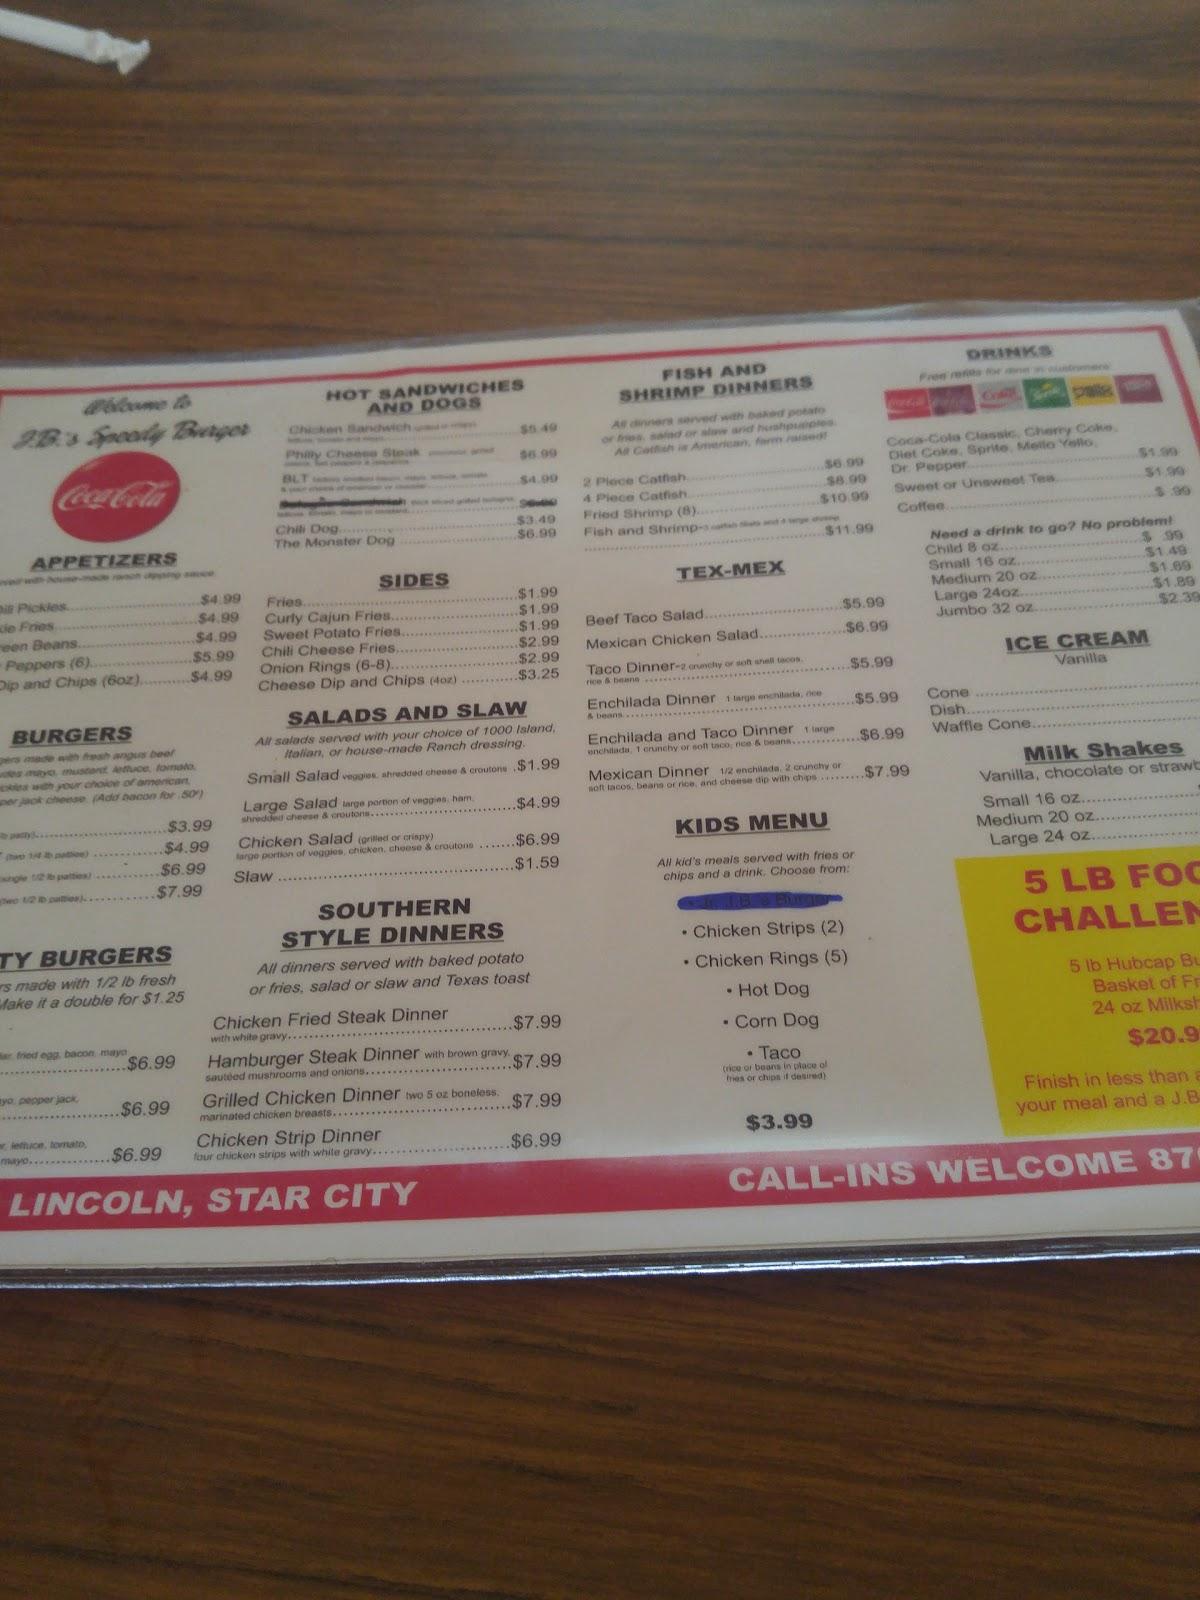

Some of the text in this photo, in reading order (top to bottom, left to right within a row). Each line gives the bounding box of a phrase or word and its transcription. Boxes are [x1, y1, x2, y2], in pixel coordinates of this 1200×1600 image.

[967, 345, 1053, 361] DRINKS
[662, 364, 766, 381] FISH AND
[326, 380, 524, 401] HOT SANDWICHES
[618, 376, 813, 403] SHRIMP DINNERS
[368, 397, 482, 416] AND DOGS
[87, 425, 166, 447] Speedy
[172, 420, 250, 440] Burger
[583, 458, 864, 487] 2 Piece Catfish $6.99
[584, 510, 618, 520] Fried
[624, 508, 673, 519] Shrimp
[897, 501, 945, 512] Coffee
[274, 528, 556, 549] The Monster Dog $6.99
[931, 516, 1173, 541] Need a drink to go? No problem!
[30, 553, 178, 571] APPETIZERS
[929, 545, 1187, 571] Small 16 oz $1.49
[677, 560, 785, 580] TEX-MEX
[378, 573, 450, 588] SIDES
[267, 587, 558, 607] Fries $1.99
[586, 596, 885, 626] Beef Taco Salad $5.99
[264, 619, 559, 641] Sweet Potato Fries $1.99
[586, 621, 888, 650] Mexican Chicken Salad $6.99
[1005, 630, 1149, 651] ICE CREAM
[260, 651, 559, 674] Onion Rings (6-8) $2.99
[1055, 653, 1107, 665] Vanilla
[23, 678, 50, 690] and
[55, 675, 97, 690] Chips
[191, 670, 232, 683] $4.99
[588, 691, 899, 710] Enchilada Dinner $5.99
[287, 701, 527, 726] SALADS AND SLAW
[12, 726, 132, 745] BURGERS
[933, 718, 1031, 734] Waffle Cone
[1024, 741, 1184, 762] Milk Shakes
[248, 771, 290, 784] Small
[295, 769, 339, 783] Salad
[517, 758, 560, 772] $1.99
[589, 765, 910, 781] Mexican Dinner $7.99
[168, 819, 212, 833] $3.99
[675, 812, 829, 834] KIDS MENU
[976, 811, 1094, 827] Medium 20 oz
[165, 841, 209, 855] $4.99
[990, 830, 1091, 847] Large 24 oz
[161, 863, 206, 877] $6.99
[233, 856, 559, 883] Slaw $1.59
[1024, 867, 1116, 894] 5 LB
[157, 885, 202, 899] $7.99
[318, 898, 471, 920] SOUTHERN
[281, 922, 504, 948] STYLE DINNERS
[693, 920, 844, 938] Chicken Strips (2)
[40, 946, 172, 969] BURGERS
[695, 950, 848, 968] Chicken Rings (5)
[1069, 956, 1174, 973] 5 lb Hubcap
[39, 991, 185, 1008] it a double for $1.25
[739, 982, 810, 997] Hot Dog
[213, 1008, 562, 1031] Chicken Fried Steak Dinner $7.99
[735, 1013, 819, 1029] Corn Dog
[127, 1055, 175, 1071] $6.99
[208, 1051, 304, 1069] Hamburger
[309, 1048, 358, 1064] Steak
[363, 1047, 420, 1062] Dinner
[424, 1050, 444, 1059] with
[448, 1049, 478, 1058] brown
[512, 1053, 562, 1070] $7.99
[759, 1046, 801, 1060] Taco
[1024, 1069, 1189, 1090] Finish in less than
[202, 1088, 562, 1109] Grilled Chicken Dinner $7.99
[121, 1101, 170, 1117] $6.99
[746, 1113, 813, 1131] $3.99
[728, 1149, 1138, 1193] CALL-INS WELCOME
[8, 1181, 418, 1218] LINCOLN, STAR CITY
